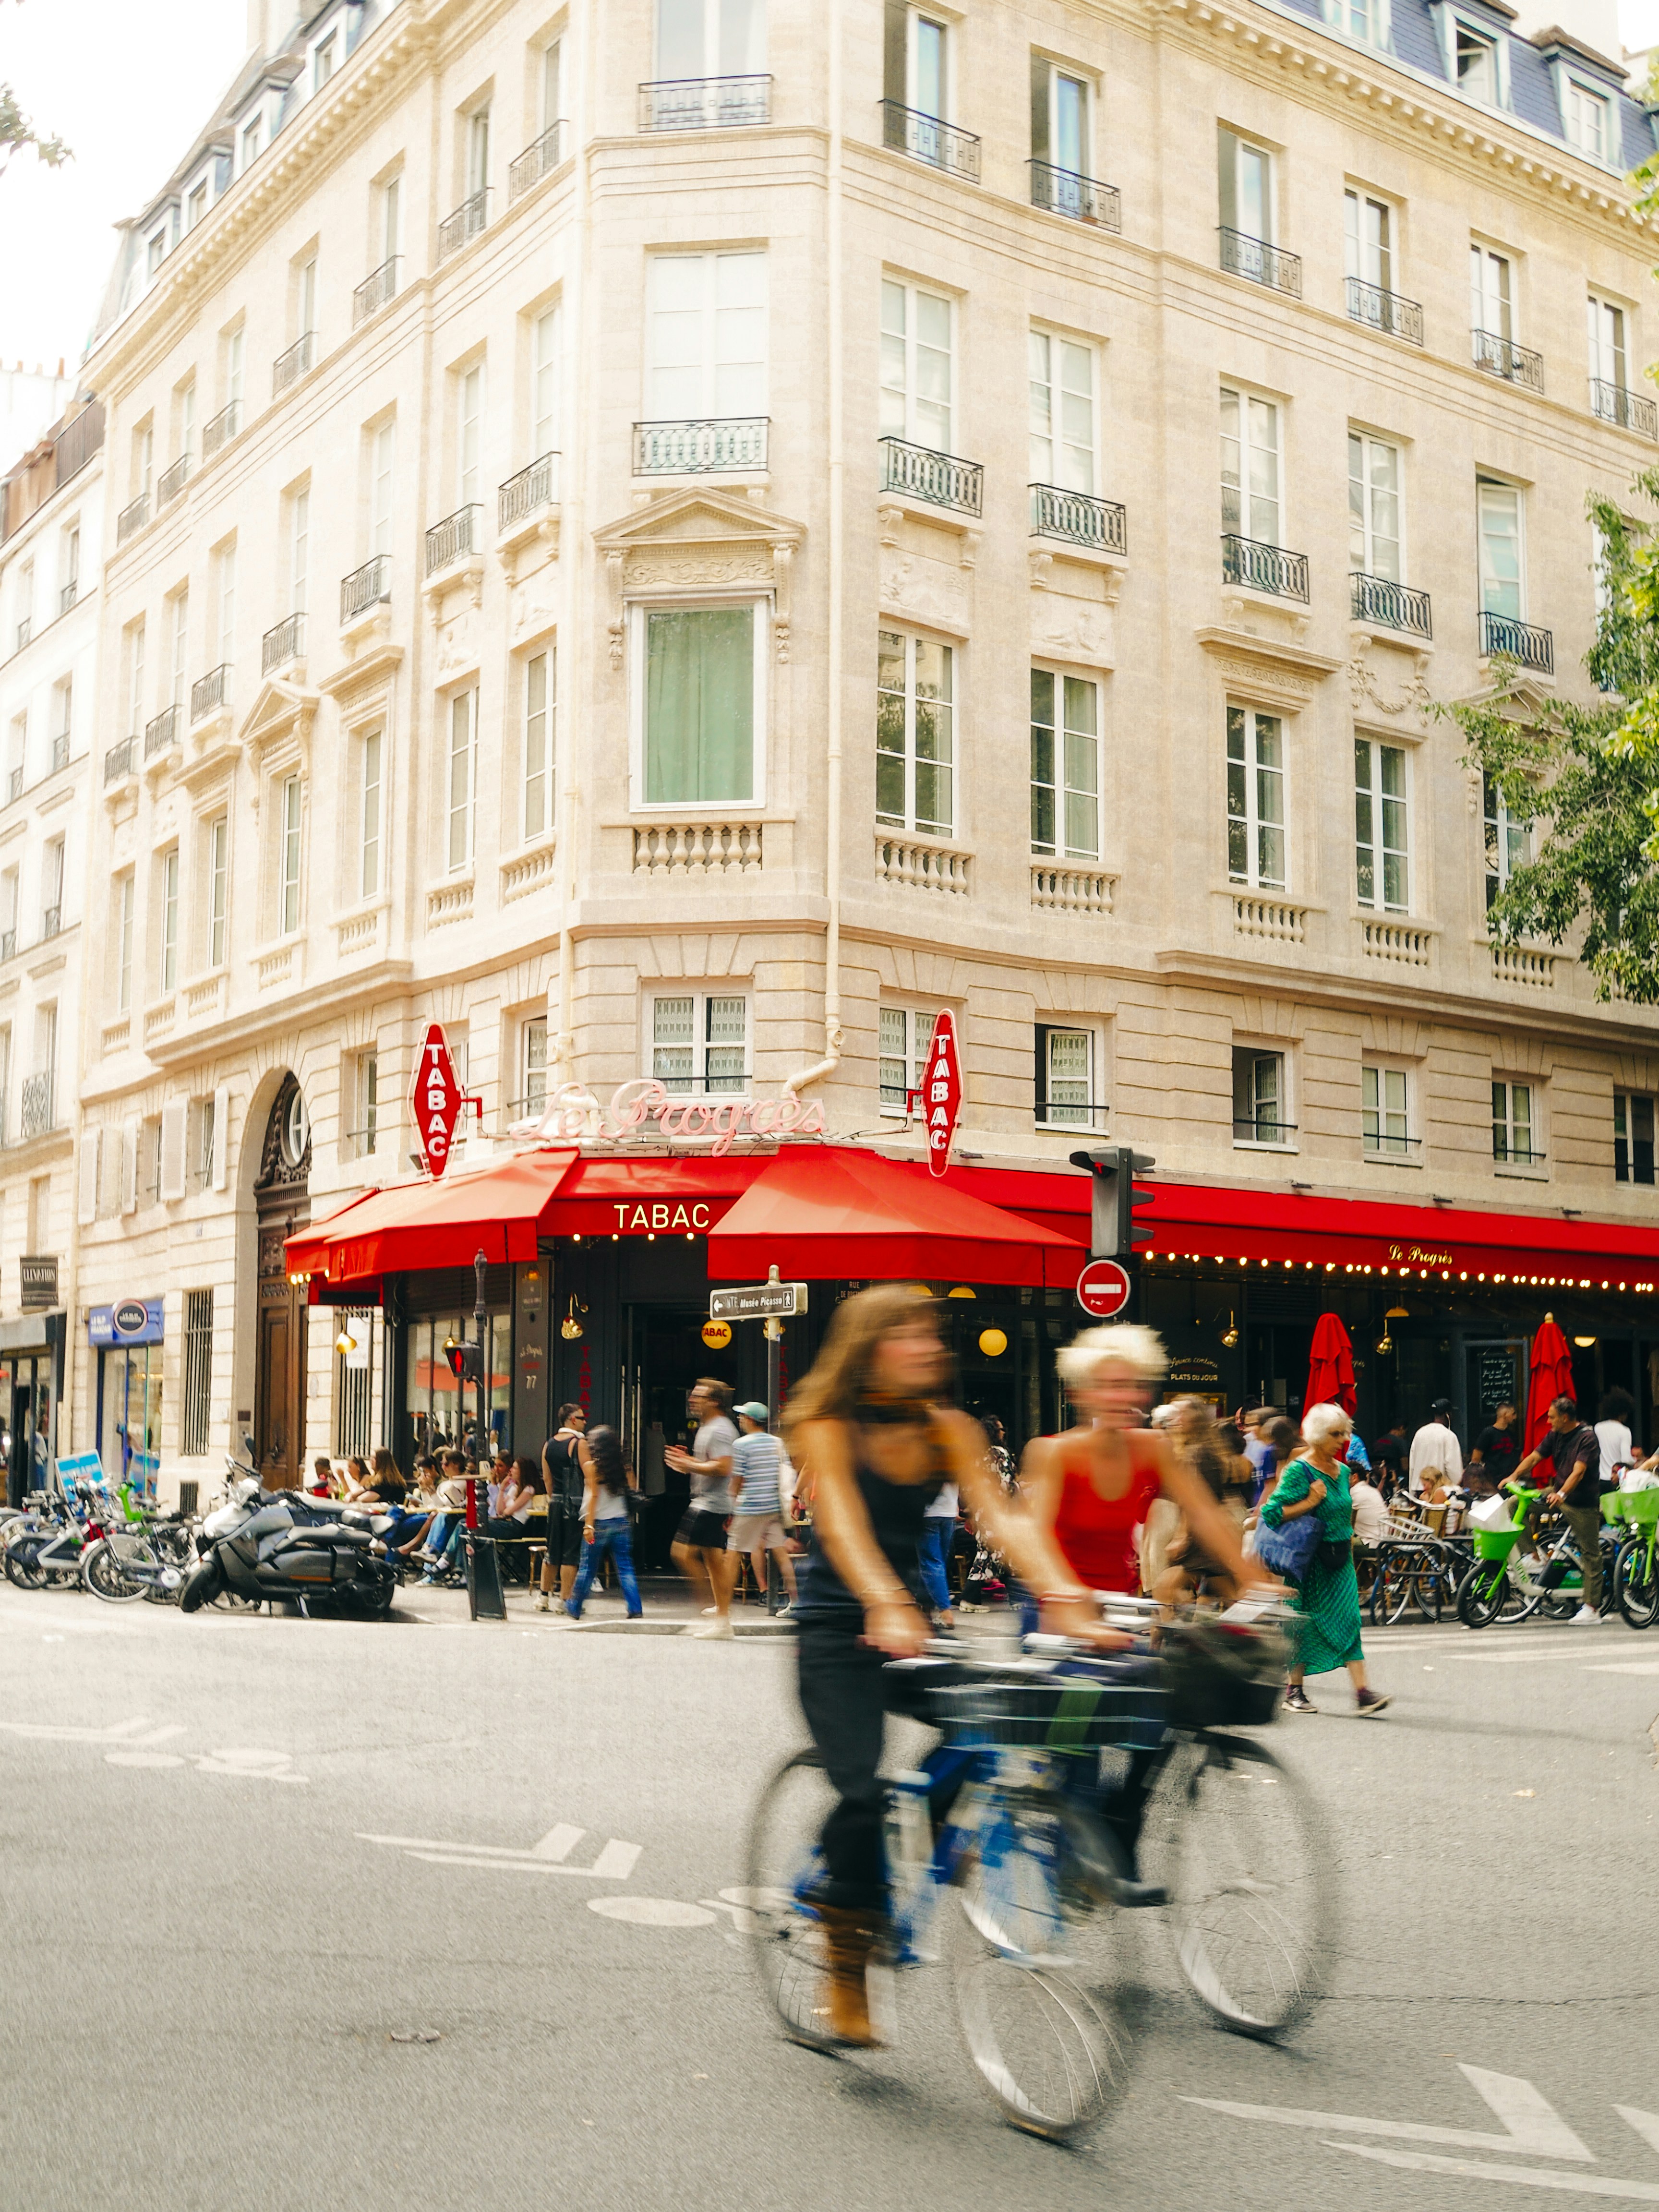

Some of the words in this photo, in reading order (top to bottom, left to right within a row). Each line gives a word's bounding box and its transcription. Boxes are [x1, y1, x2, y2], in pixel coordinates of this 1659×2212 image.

[426, 1044, 448, 1156] TABAC
[930, 1034, 950, 1150] TABAC
[511, 1082, 587, 1140] Le
[599, 1079, 826, 1157] Progrès
[613, 1203, 709, 1228] TABAC
[1388, 1244, 1403, 1261] Le
[1408, 1246, 1452, 1267] Progrès
[740, 1298, 758, 1308] Musée
[760, 1297, 782, 1306] Picasso
[702, 1328, 727, 1337] TABAC
